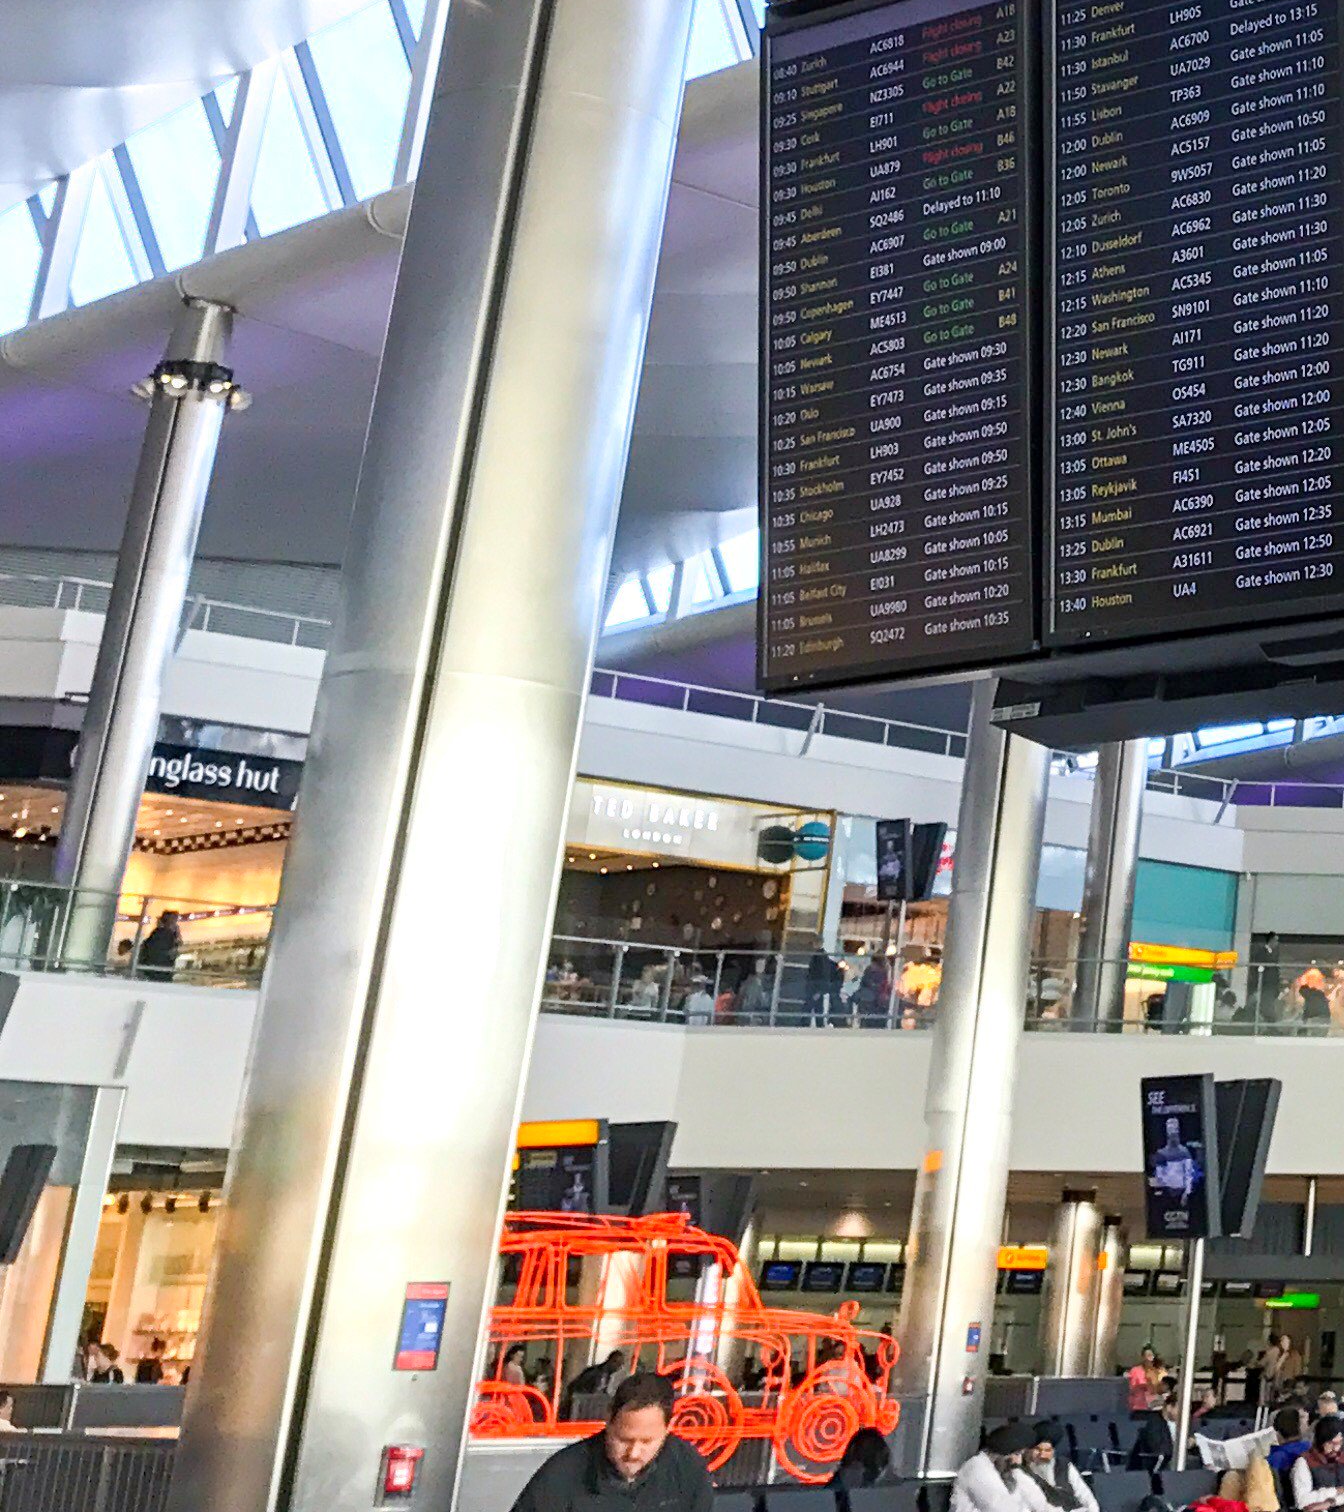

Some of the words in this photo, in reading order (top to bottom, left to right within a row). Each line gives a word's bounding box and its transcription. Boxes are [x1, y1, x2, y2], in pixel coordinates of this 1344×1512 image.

[1061, 296, 1086, 312] 12:15
[1171, 271, 1211, 290] AC5345
[1233, 264, 1258, 278] Gate
[1260, 257, 1296, 273] shown
[1299, 247, 1327, 264] 11:05
[236, 760, 279, 793] hut
[593, 795, 634, 821] TED
[649, 803, 719, 832] BAKER
